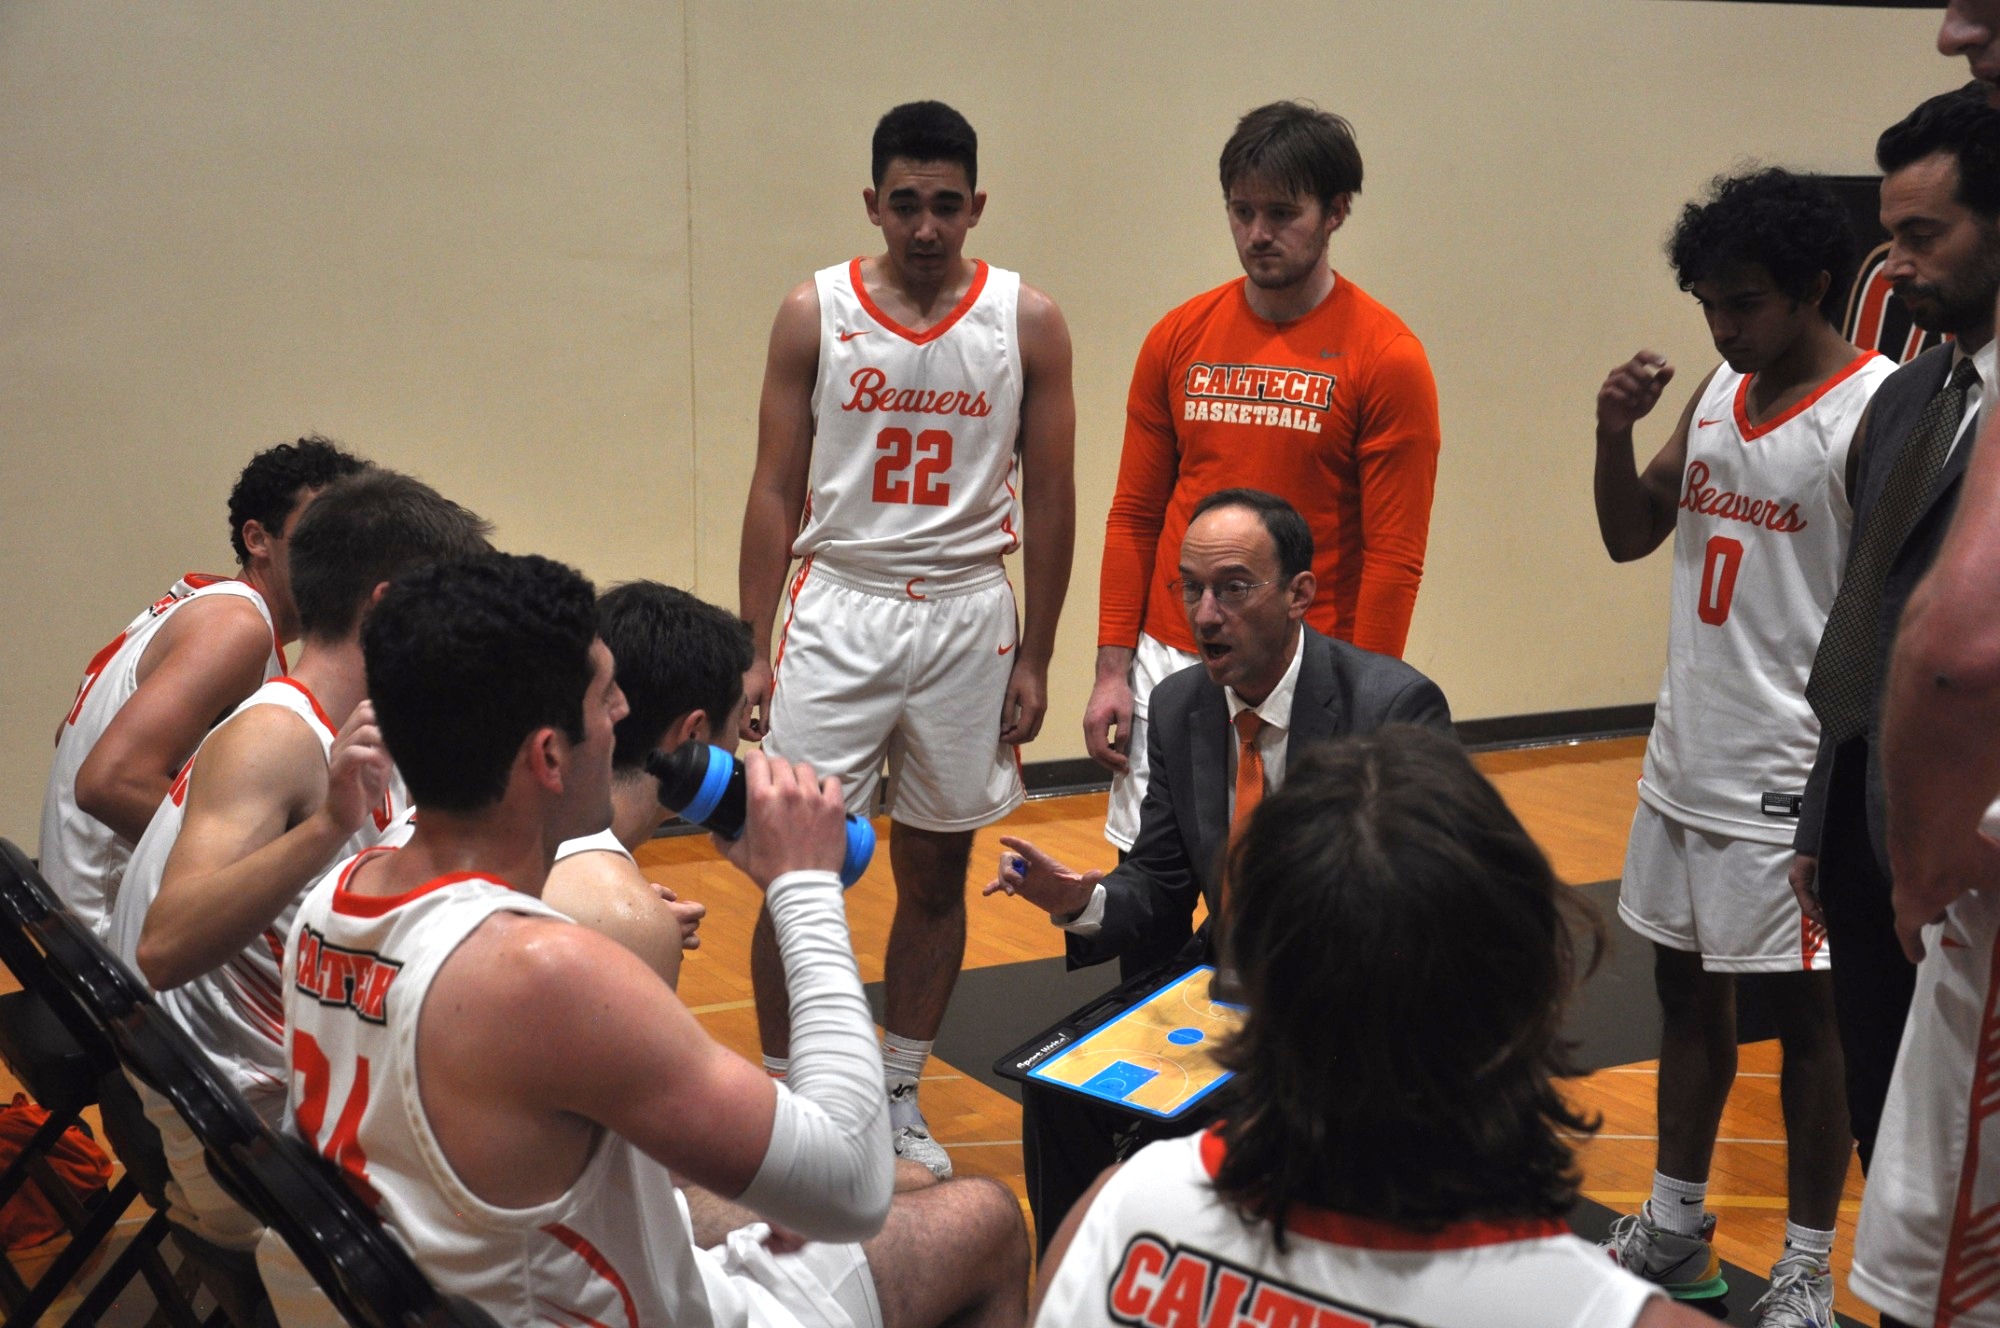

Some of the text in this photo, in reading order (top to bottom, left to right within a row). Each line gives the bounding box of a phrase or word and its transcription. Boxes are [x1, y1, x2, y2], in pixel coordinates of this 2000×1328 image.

[841, 367, 992, 417] Beavers
[1184, 400, 1322, 434] BASKETBALL
[1185, 361, 1337, 411] CALTECH
[872, 427, 953, 507] 22
[1679, 460, 1808, 533] Beavers
[1698, 535, 1744, 627] 0
[296, 924, 403, 1026] CALTEH
